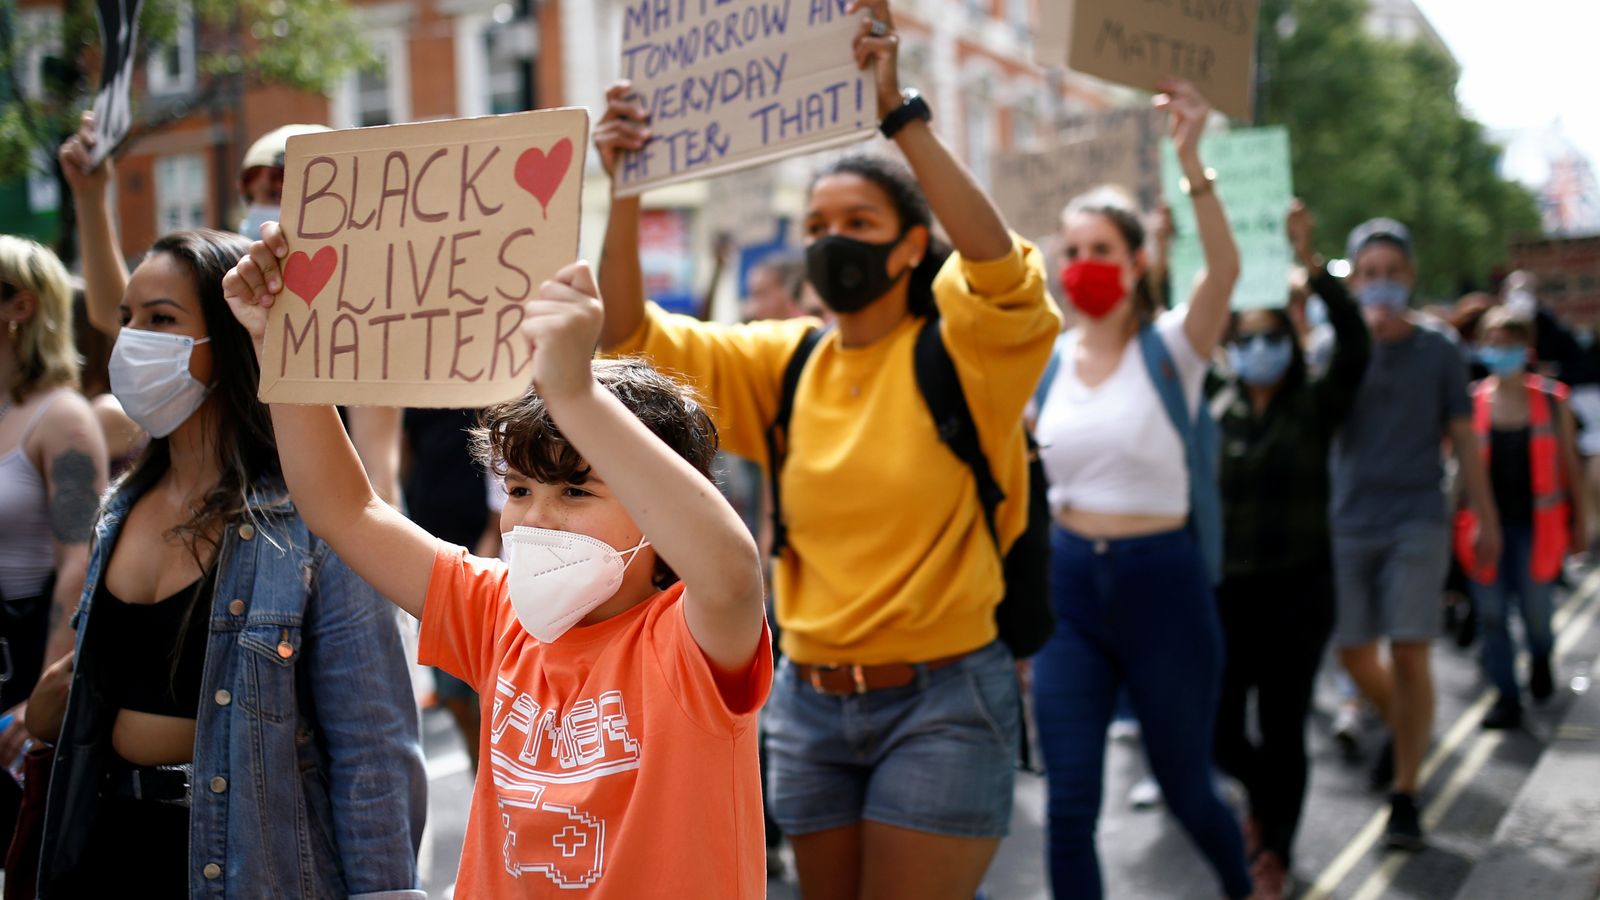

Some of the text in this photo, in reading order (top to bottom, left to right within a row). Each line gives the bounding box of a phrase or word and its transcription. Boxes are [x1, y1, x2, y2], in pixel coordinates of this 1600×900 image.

[622, 0, 852, 82] TOMORROW AN
[623, 0, 734, 41] MAT
[623, 78, 863, 183] AFTER THAT!
[625, 53, 788, 126] VERYDAY
[298, 145, 503, 239] BLACK
[337, 228, 535, 315] LIVES
[280, 304, 534, 382] MATTER
